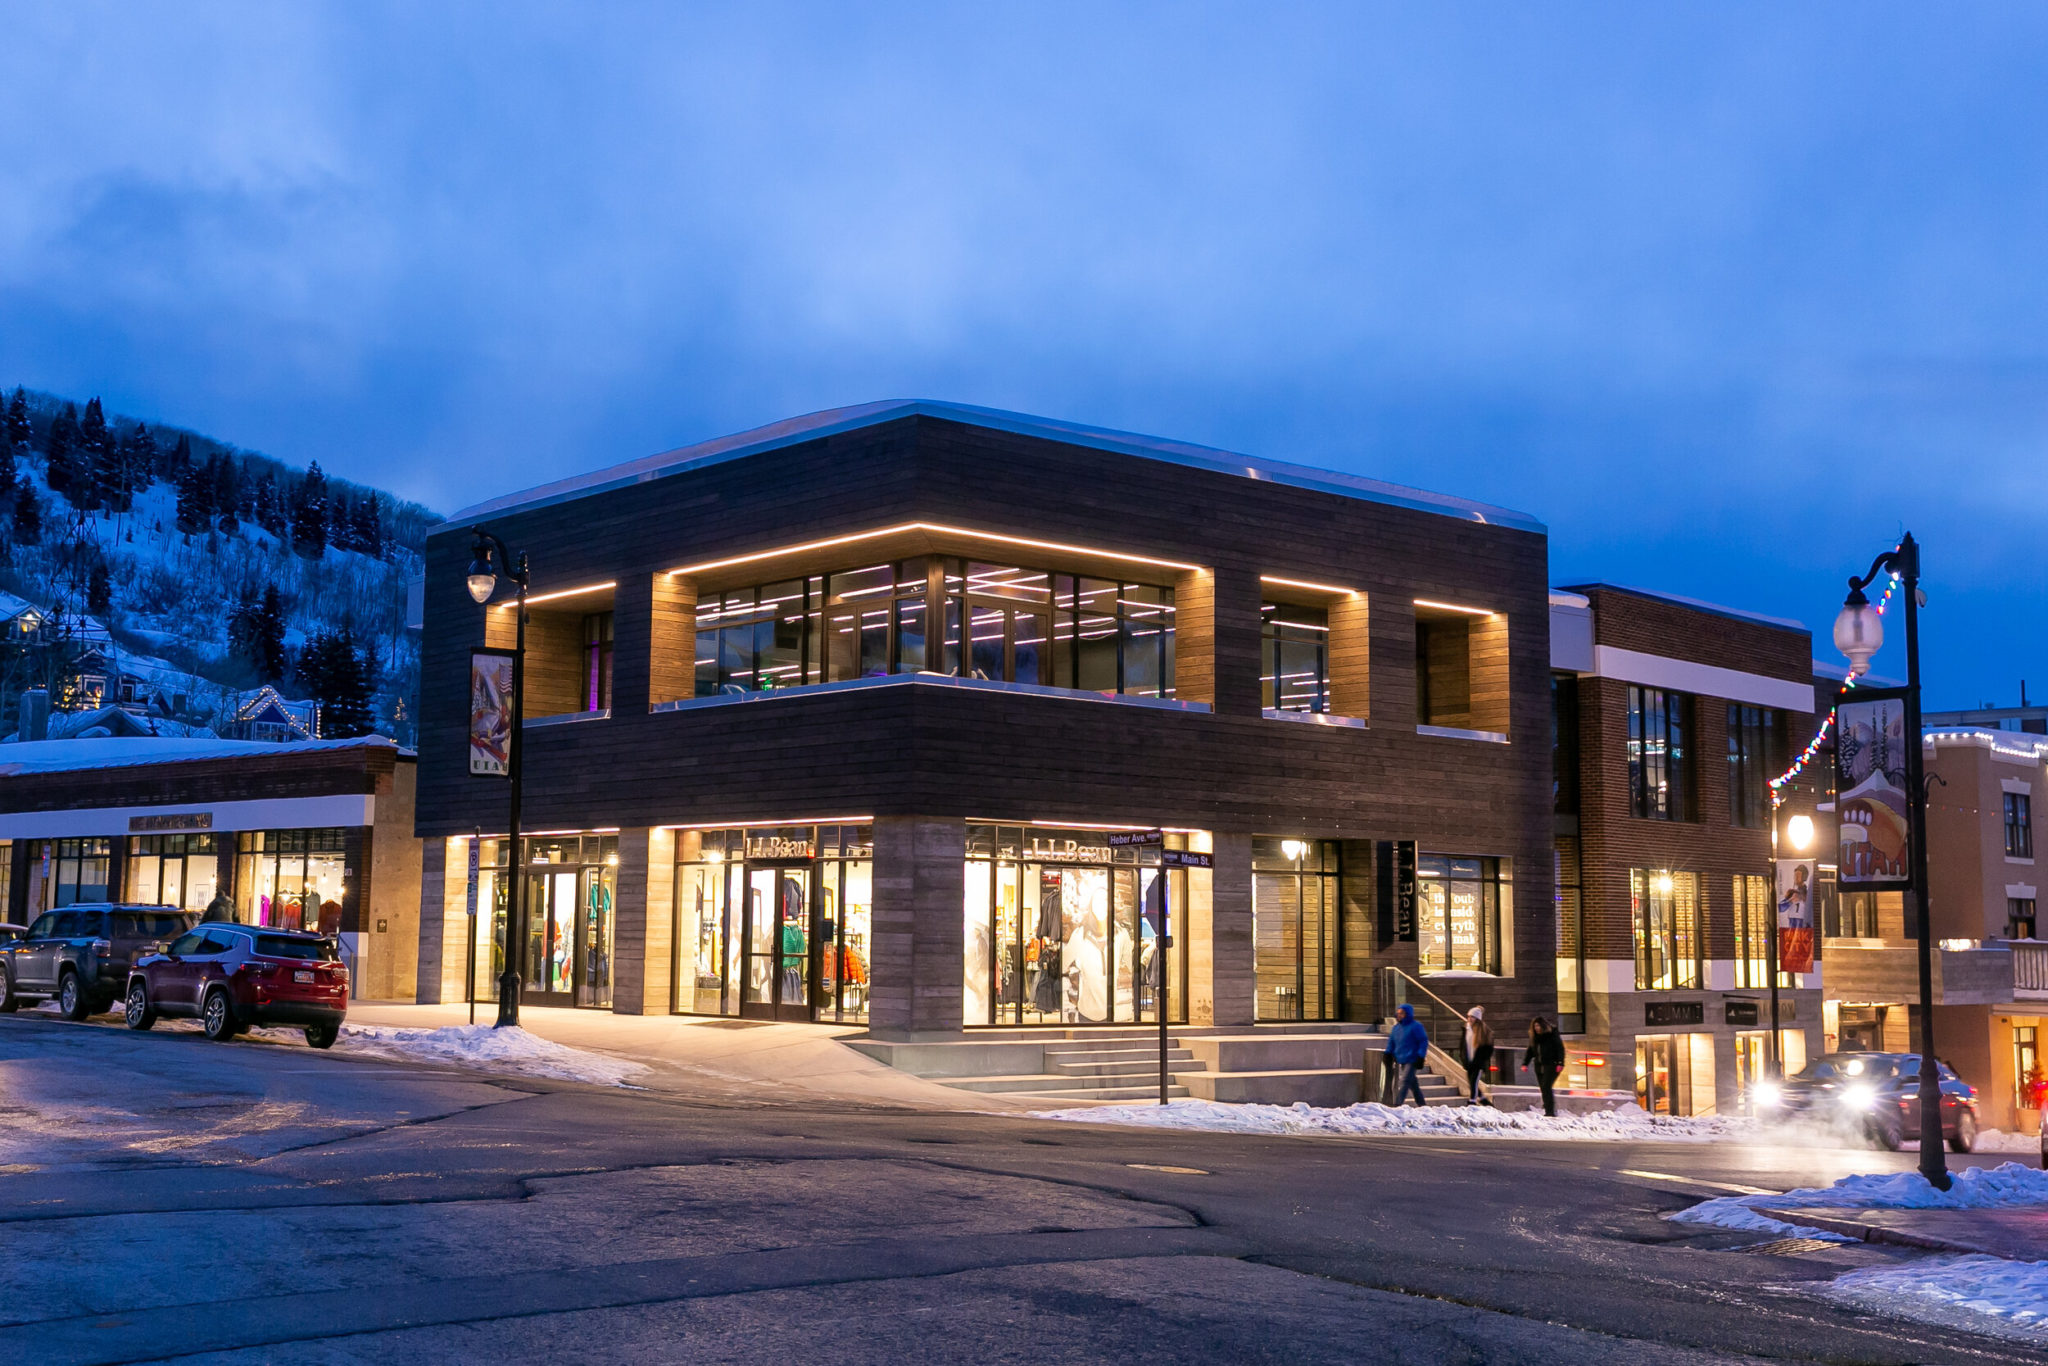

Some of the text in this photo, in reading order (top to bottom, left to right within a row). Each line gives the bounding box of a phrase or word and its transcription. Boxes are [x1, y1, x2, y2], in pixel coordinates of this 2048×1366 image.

[1110, 835, 1130, 845] Heber
[1131, 833, 1147, 843] Ave.
[1181, 854, 1199, 865] Main
[1200, 856, 1211, 866] St.
[1841, 842, 1907, 877] UTAH
[1434, 920, 1475, 934] evryth
